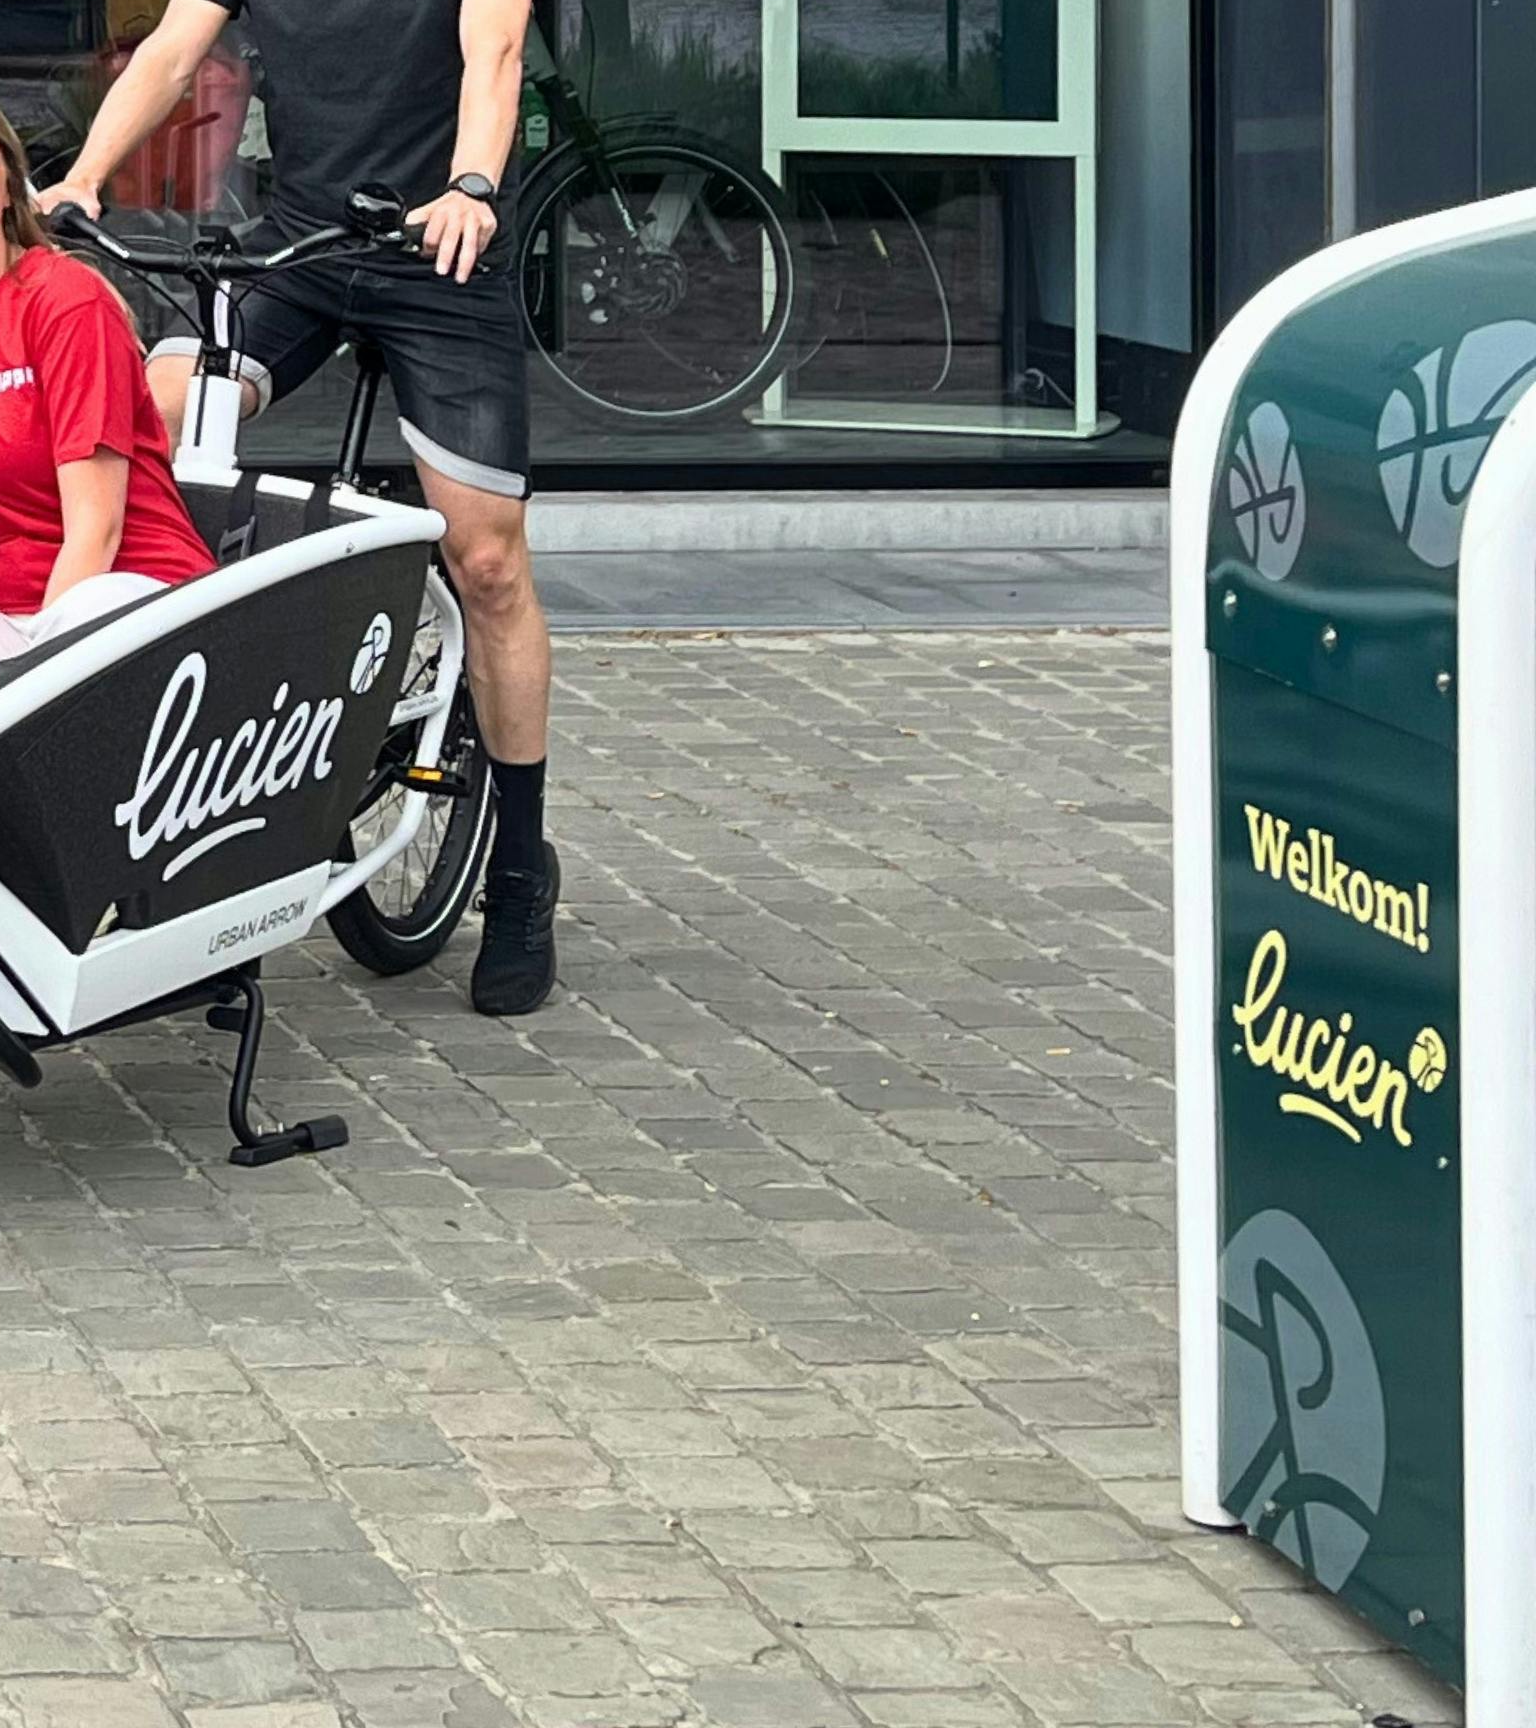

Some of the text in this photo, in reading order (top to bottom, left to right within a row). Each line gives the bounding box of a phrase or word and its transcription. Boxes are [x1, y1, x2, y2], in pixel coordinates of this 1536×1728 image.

[208, 896, 308, 955] URBAN ARROW
[1243, 803, 1430, 954] Welkom!
